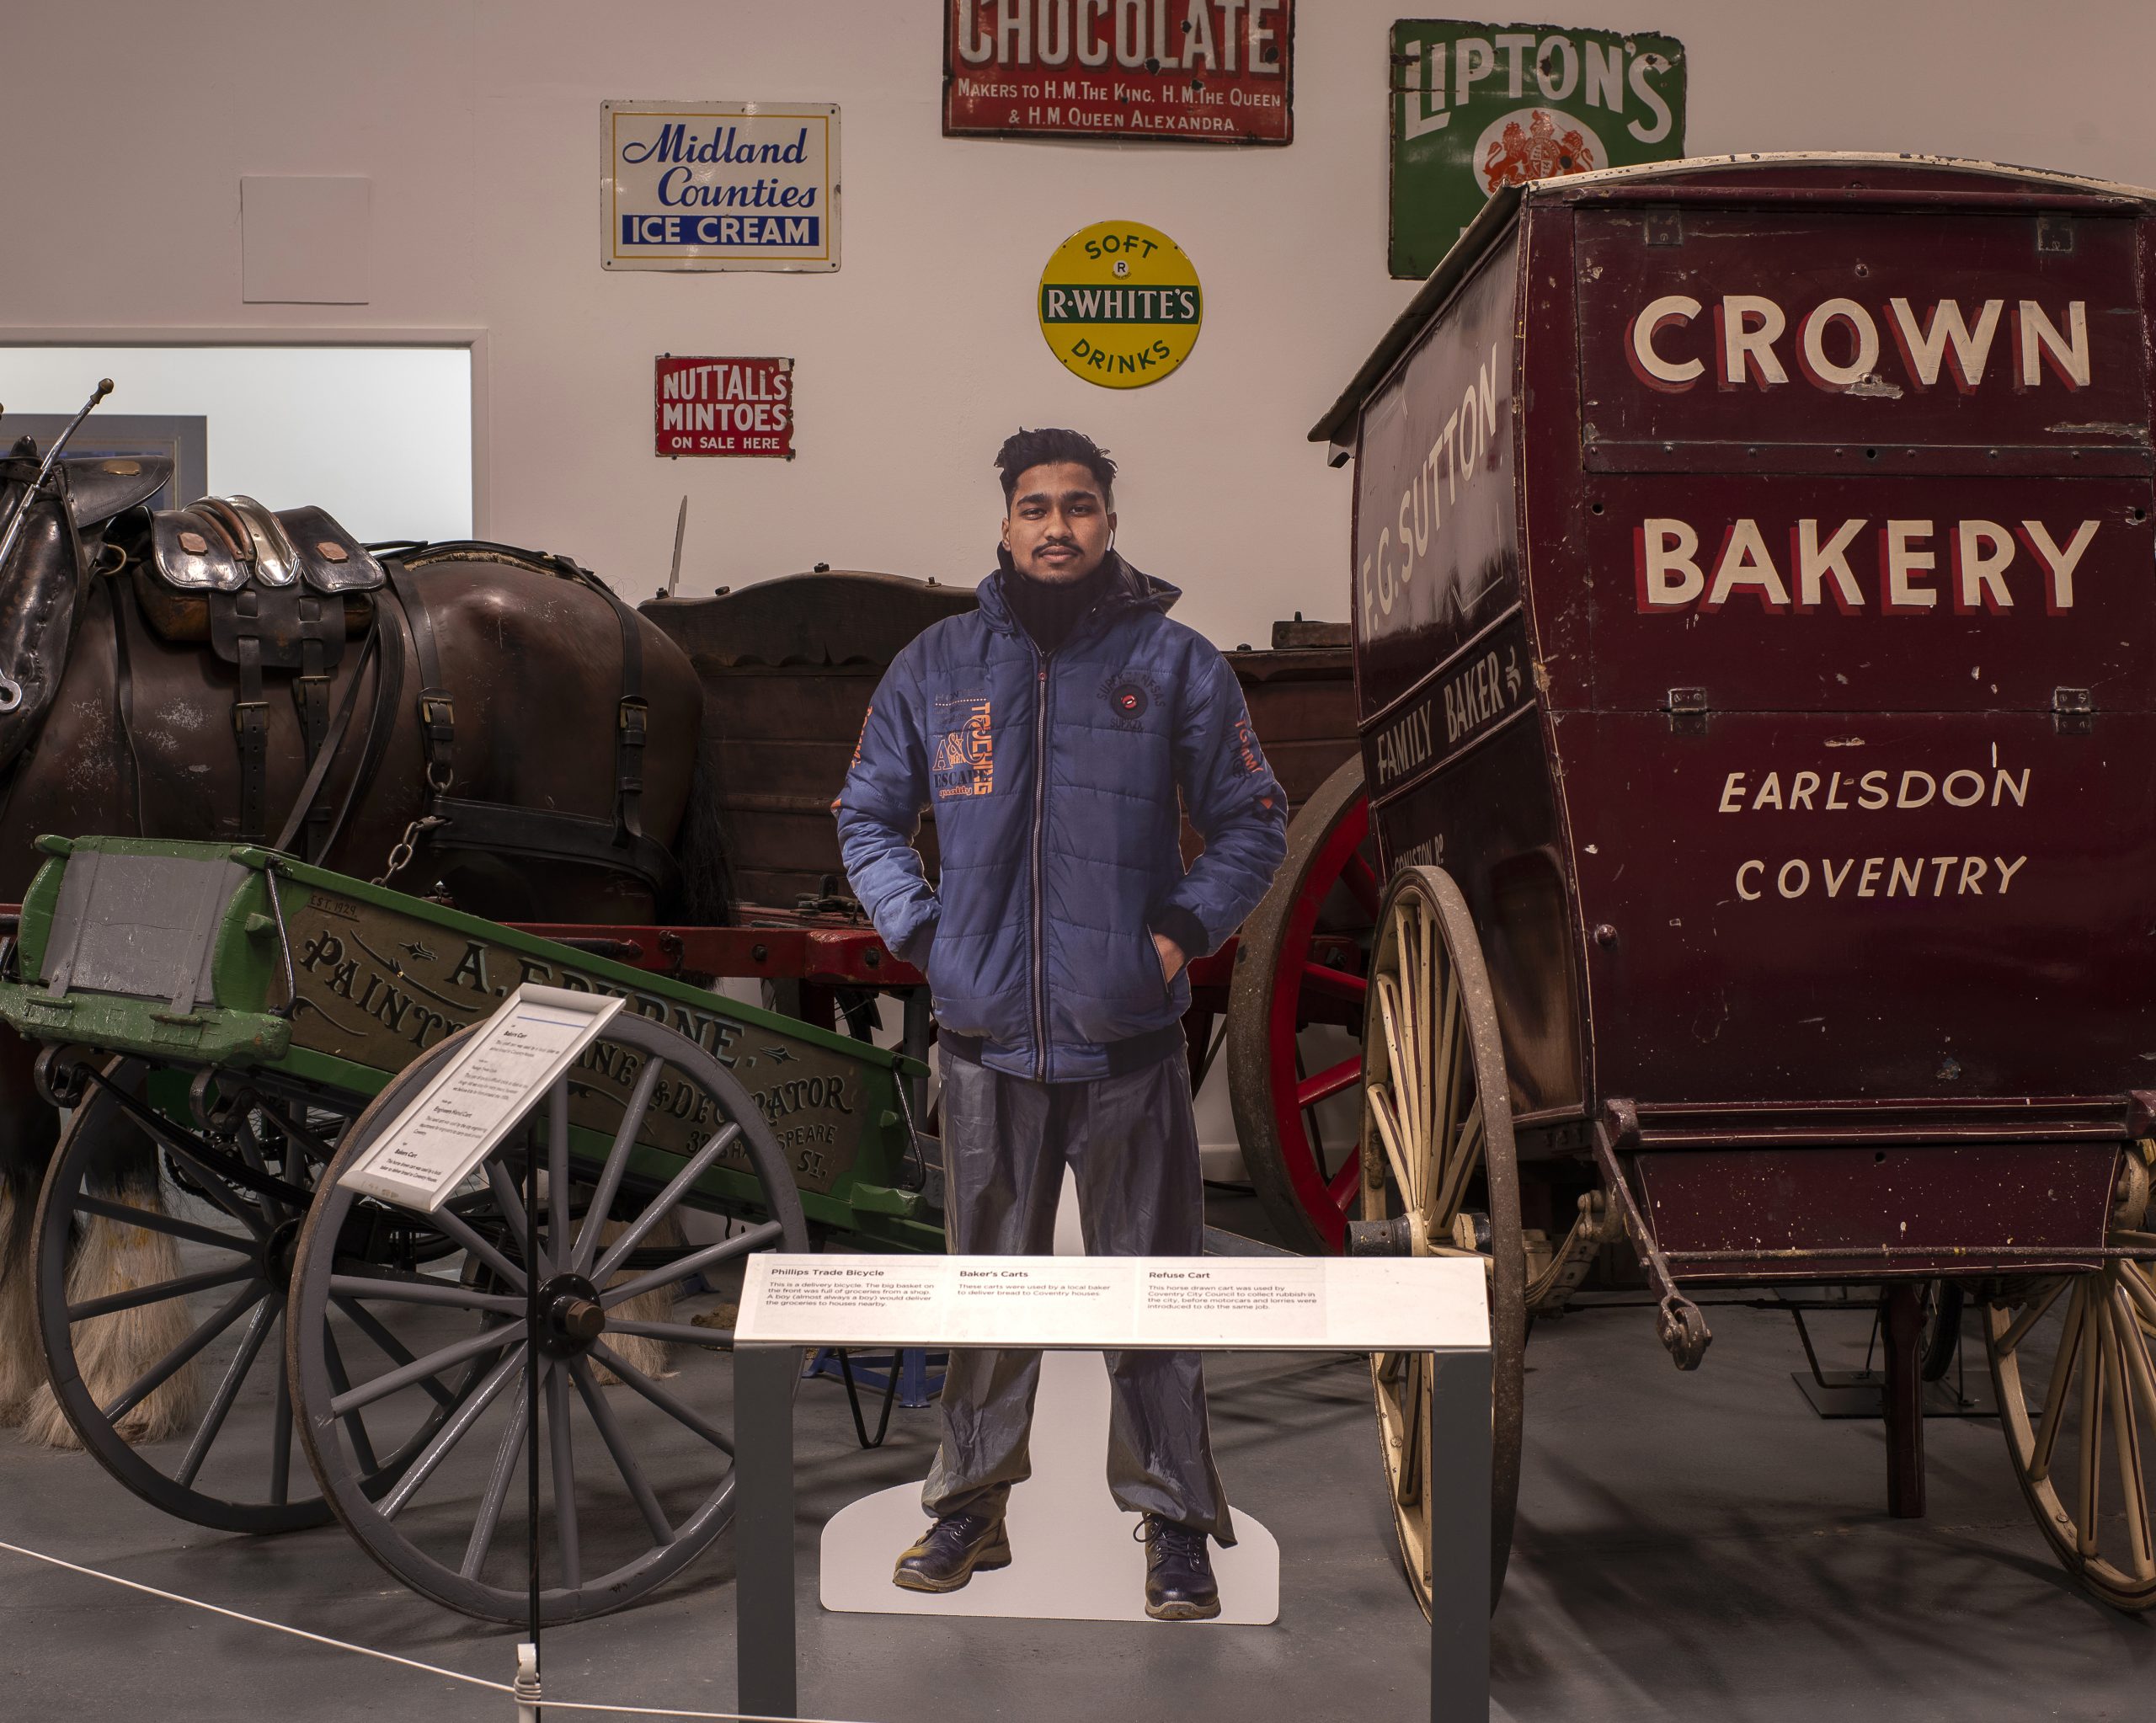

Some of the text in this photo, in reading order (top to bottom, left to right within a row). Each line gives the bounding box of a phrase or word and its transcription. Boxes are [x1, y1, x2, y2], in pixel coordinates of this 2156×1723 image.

[958, 0, 1282, 74] CHOCOLATE
[1405, 34, 1673, 144] LIPTON'S
[1008, 109, 1020, 124] &
[622, 123, 808, 164] Midland
[657, 166, 818, 209] Counties
[632, 216, 809, 244] ICE CREAM
[1085, 234, 1158, 259] SOFT
[1071, 338, 1171, 374] DRINKS
[1629, 295, 2091, 388] CROWN
[663, 365, 787, 401] NUTTALL'S
[663, 403, 787, 431] MINTOES
[671, 436, 780, 449] ON SALE HERE
[1398, 342, 1497, 583] SUTTON
[1638, 518, 2100, 610] BAKERY
[1377, 651, 1505, 786] FAMILY BAKER
[1718, 768, 2031, 813] EARLSDON
[1735, 856, 2027, 900] COVENTRY
[664, 1075, 855, 1126] DERATOR
[770, 1267, 809, 1276] Phillips
[845, 1268, 884, 1277] Bicycle
